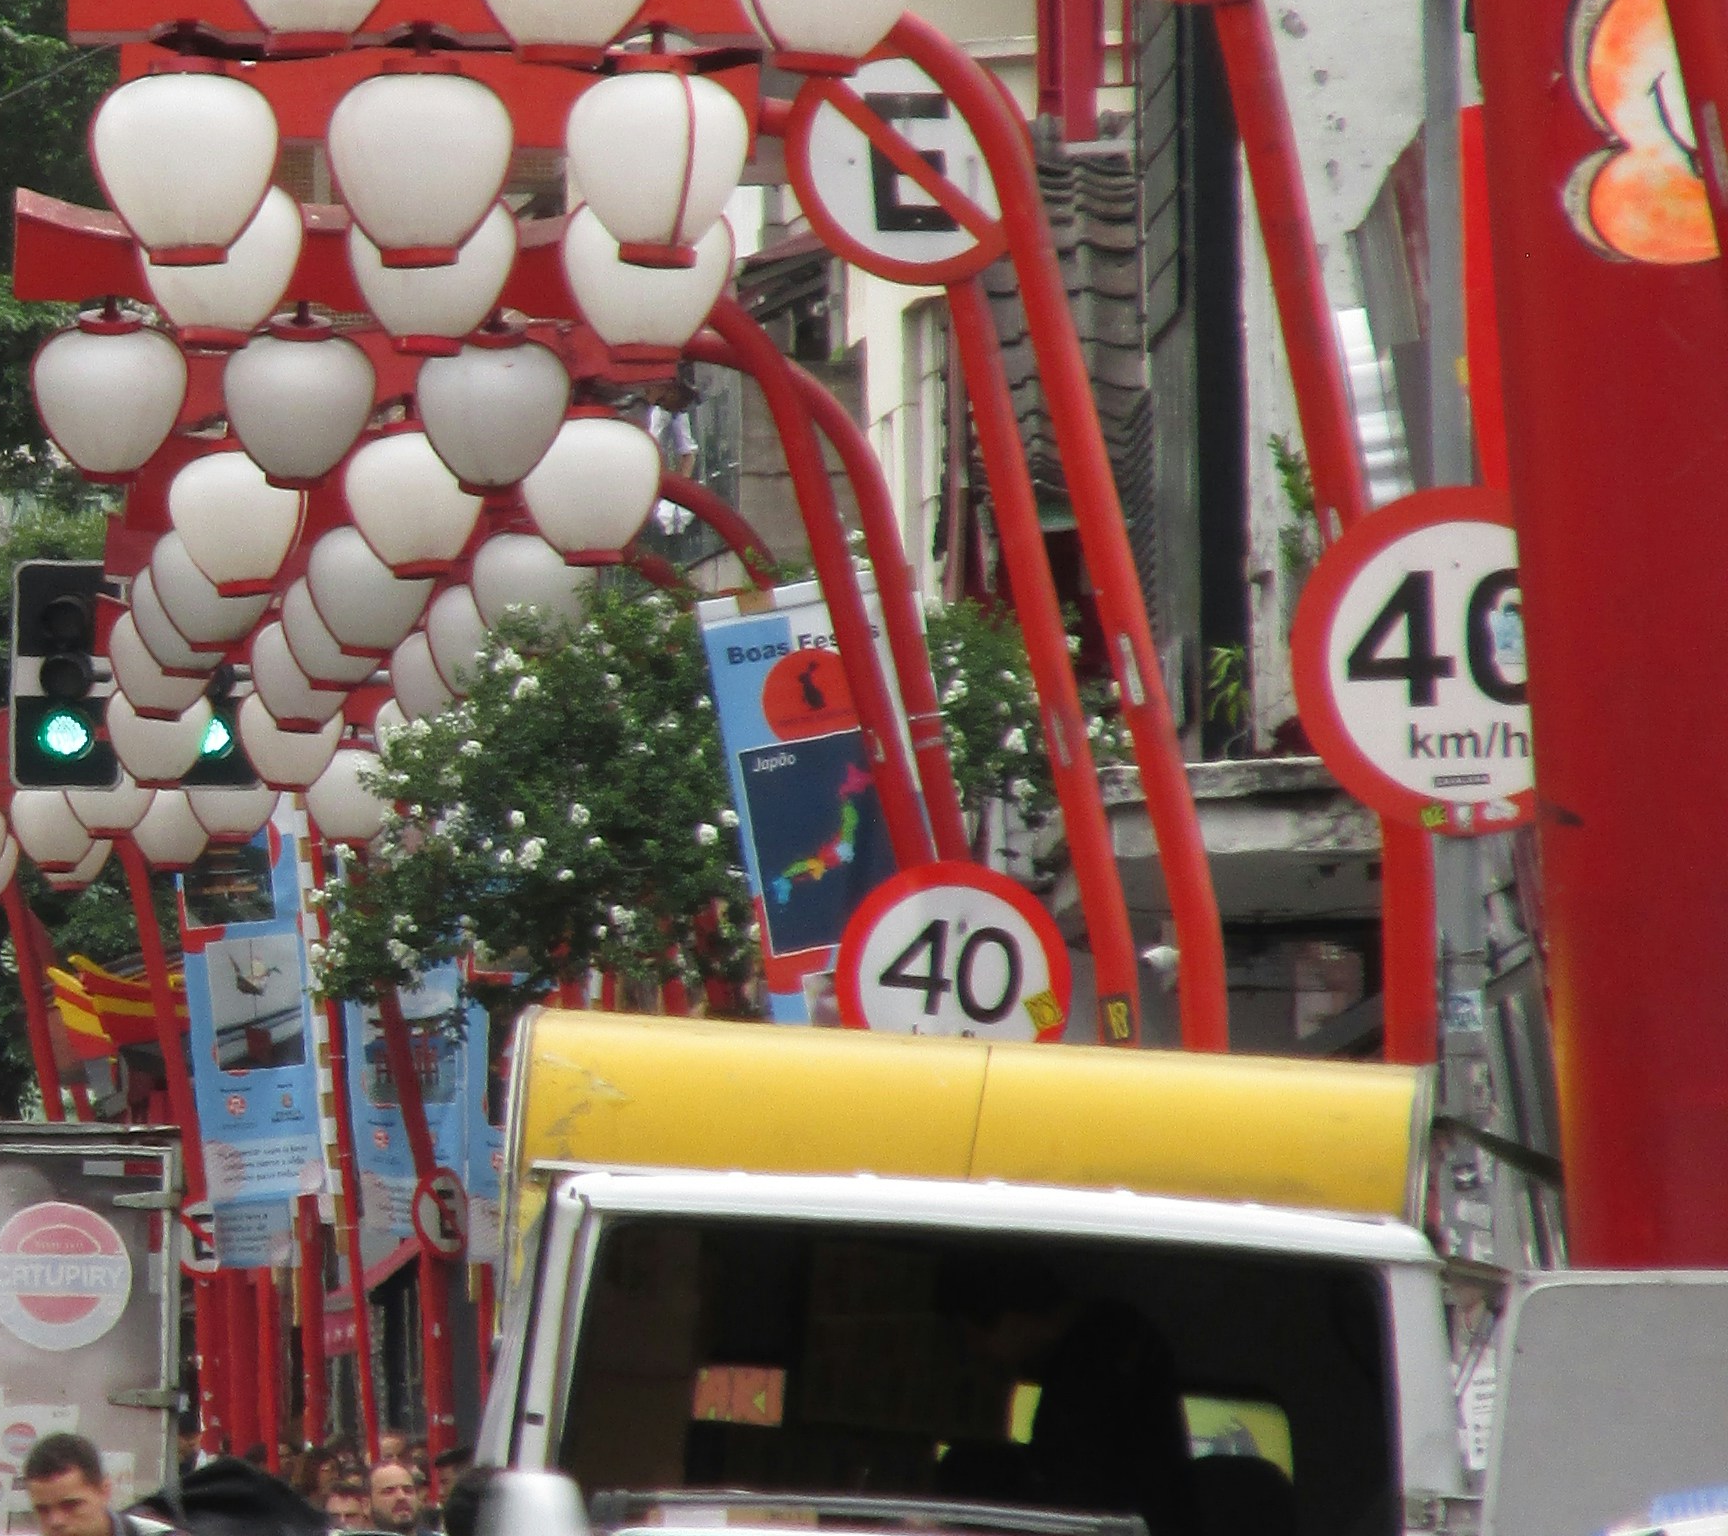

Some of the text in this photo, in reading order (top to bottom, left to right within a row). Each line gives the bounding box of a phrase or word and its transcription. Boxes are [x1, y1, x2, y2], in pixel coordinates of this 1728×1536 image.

[727, 642, 790, 665] Boas
[1409, 722, 1529, 760] km/h
[753, 751, 796, 773] Japão
[879, 918, 1024, 1025] 40
